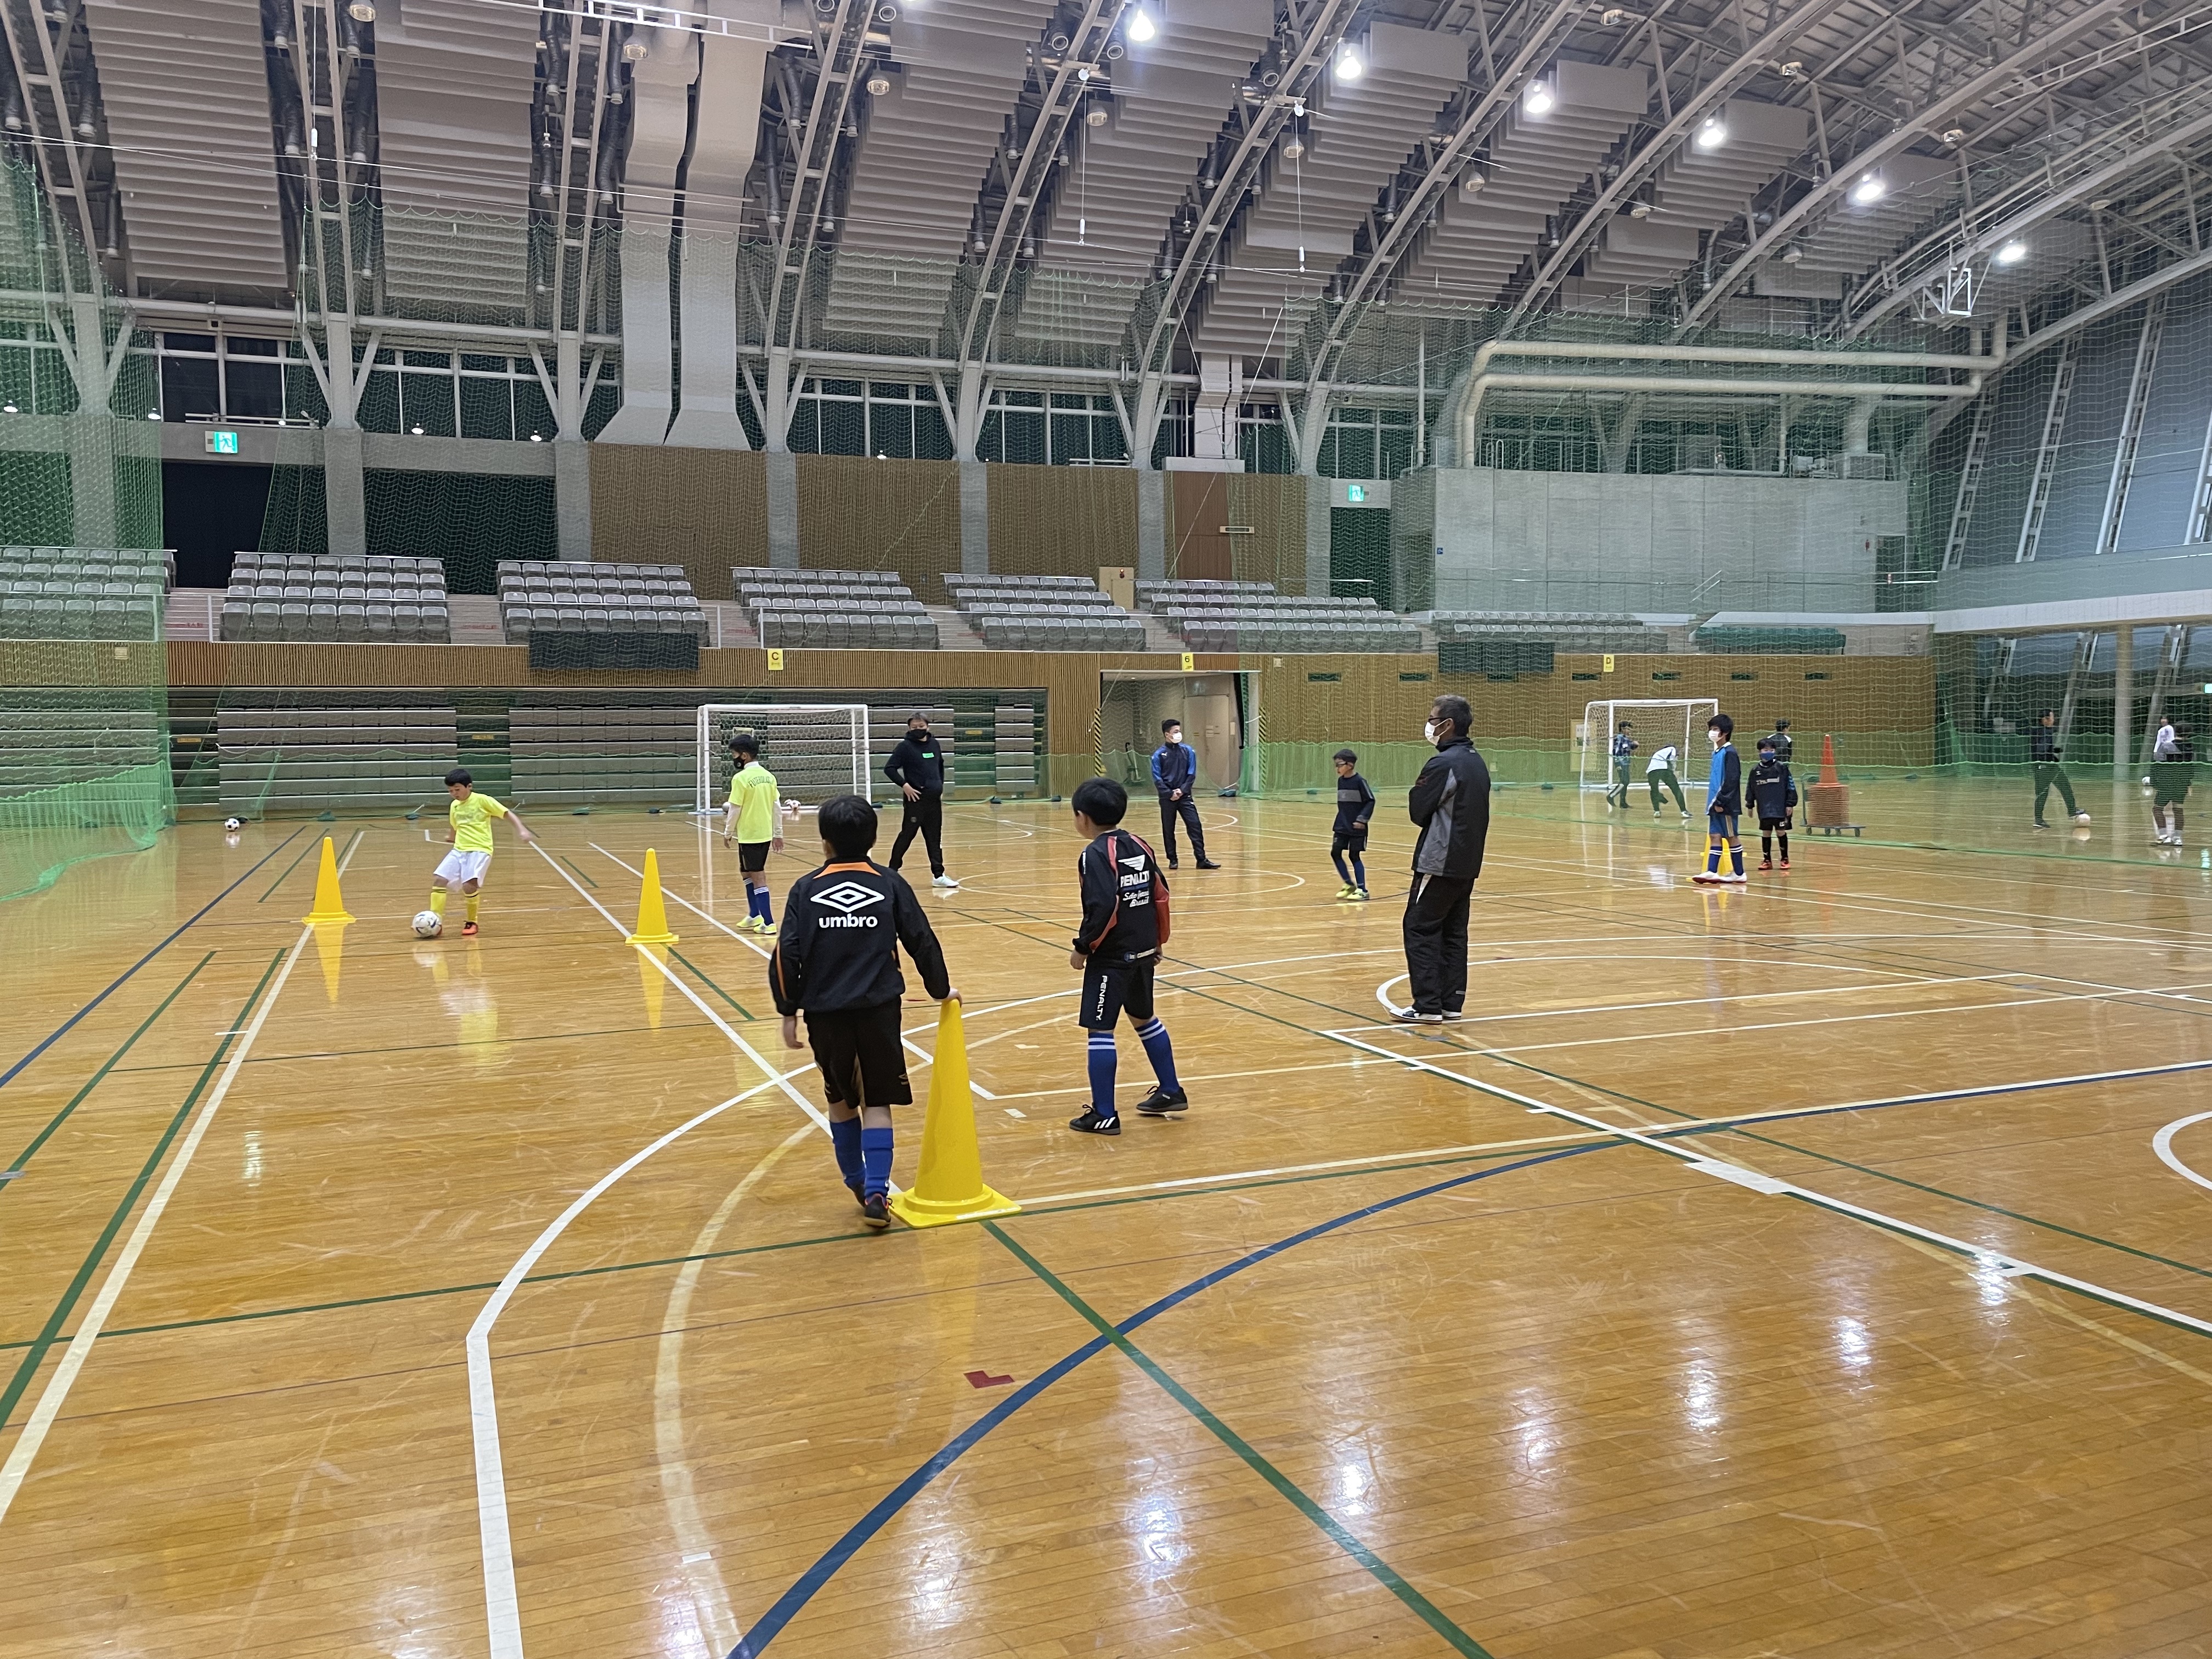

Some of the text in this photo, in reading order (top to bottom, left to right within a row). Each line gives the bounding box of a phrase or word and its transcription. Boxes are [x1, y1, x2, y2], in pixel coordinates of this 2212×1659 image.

[771, 652, 779, 661] C
[819, 913, 878, 928] umbro
[1096, 975, 1108, 1020] PENALTY
